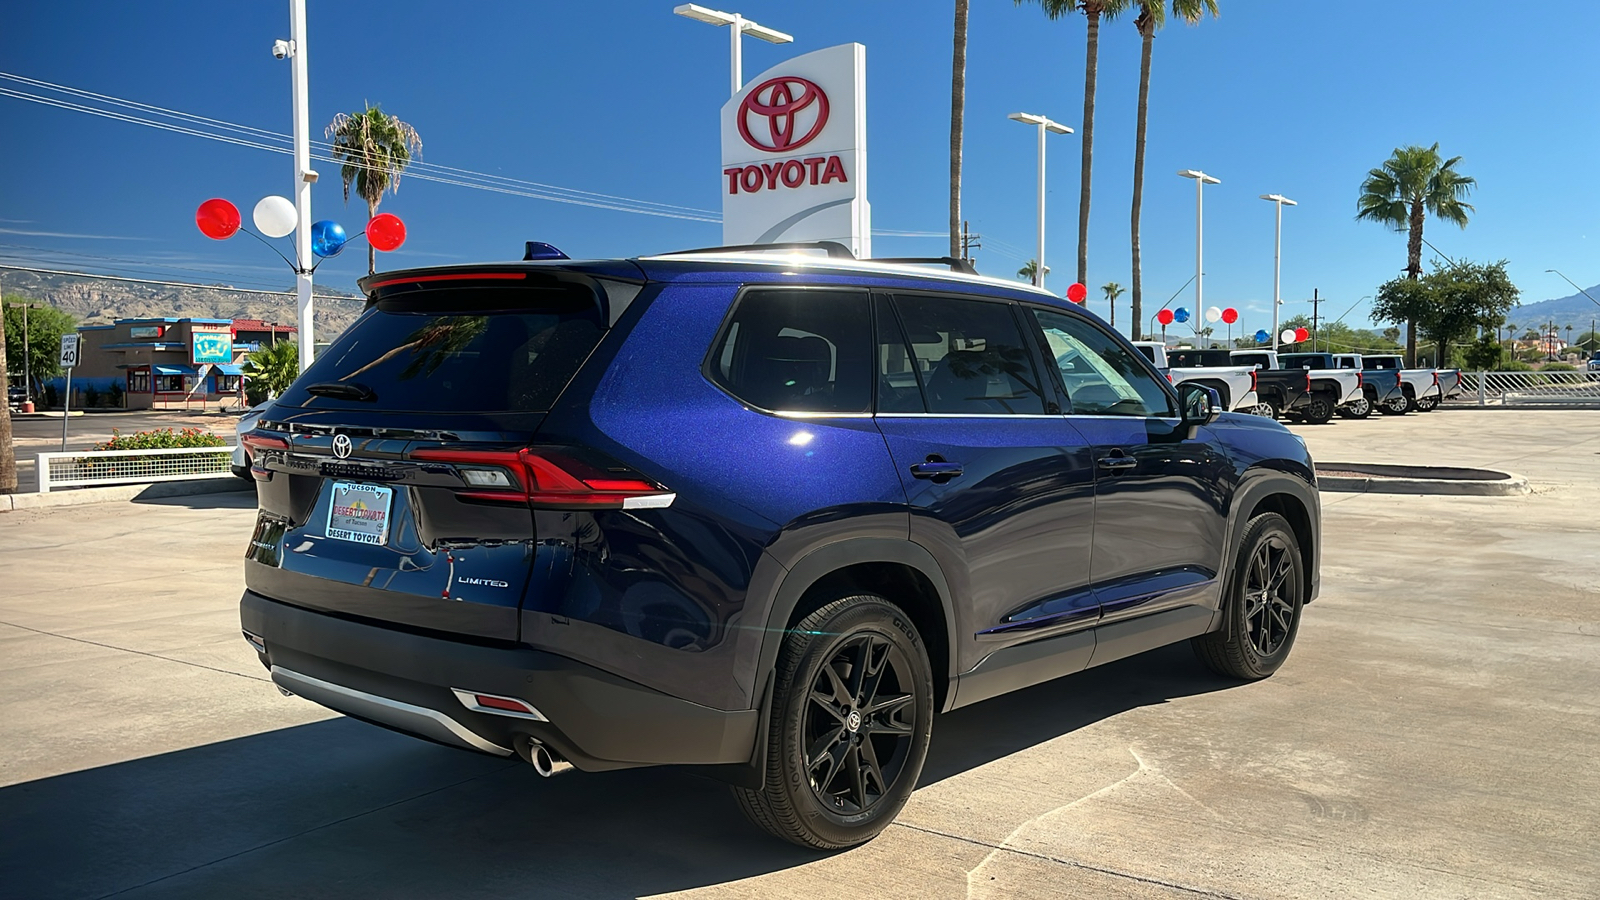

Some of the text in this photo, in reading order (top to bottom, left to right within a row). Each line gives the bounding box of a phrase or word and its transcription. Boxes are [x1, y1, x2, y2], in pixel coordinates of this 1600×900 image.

[723, 156, 848, 194] TOYOTA
[62, 351, 75, 363] 40
[347, 484, 376, 492] TUCSON
[333, 505, 385, 520] DESERT TOYOTA
[328, 529, 380, 544] DESERT TOYOTA
[458, 576, 509, 588] LIMITED
[787, 707, 801, 792] YOKOHAMA
